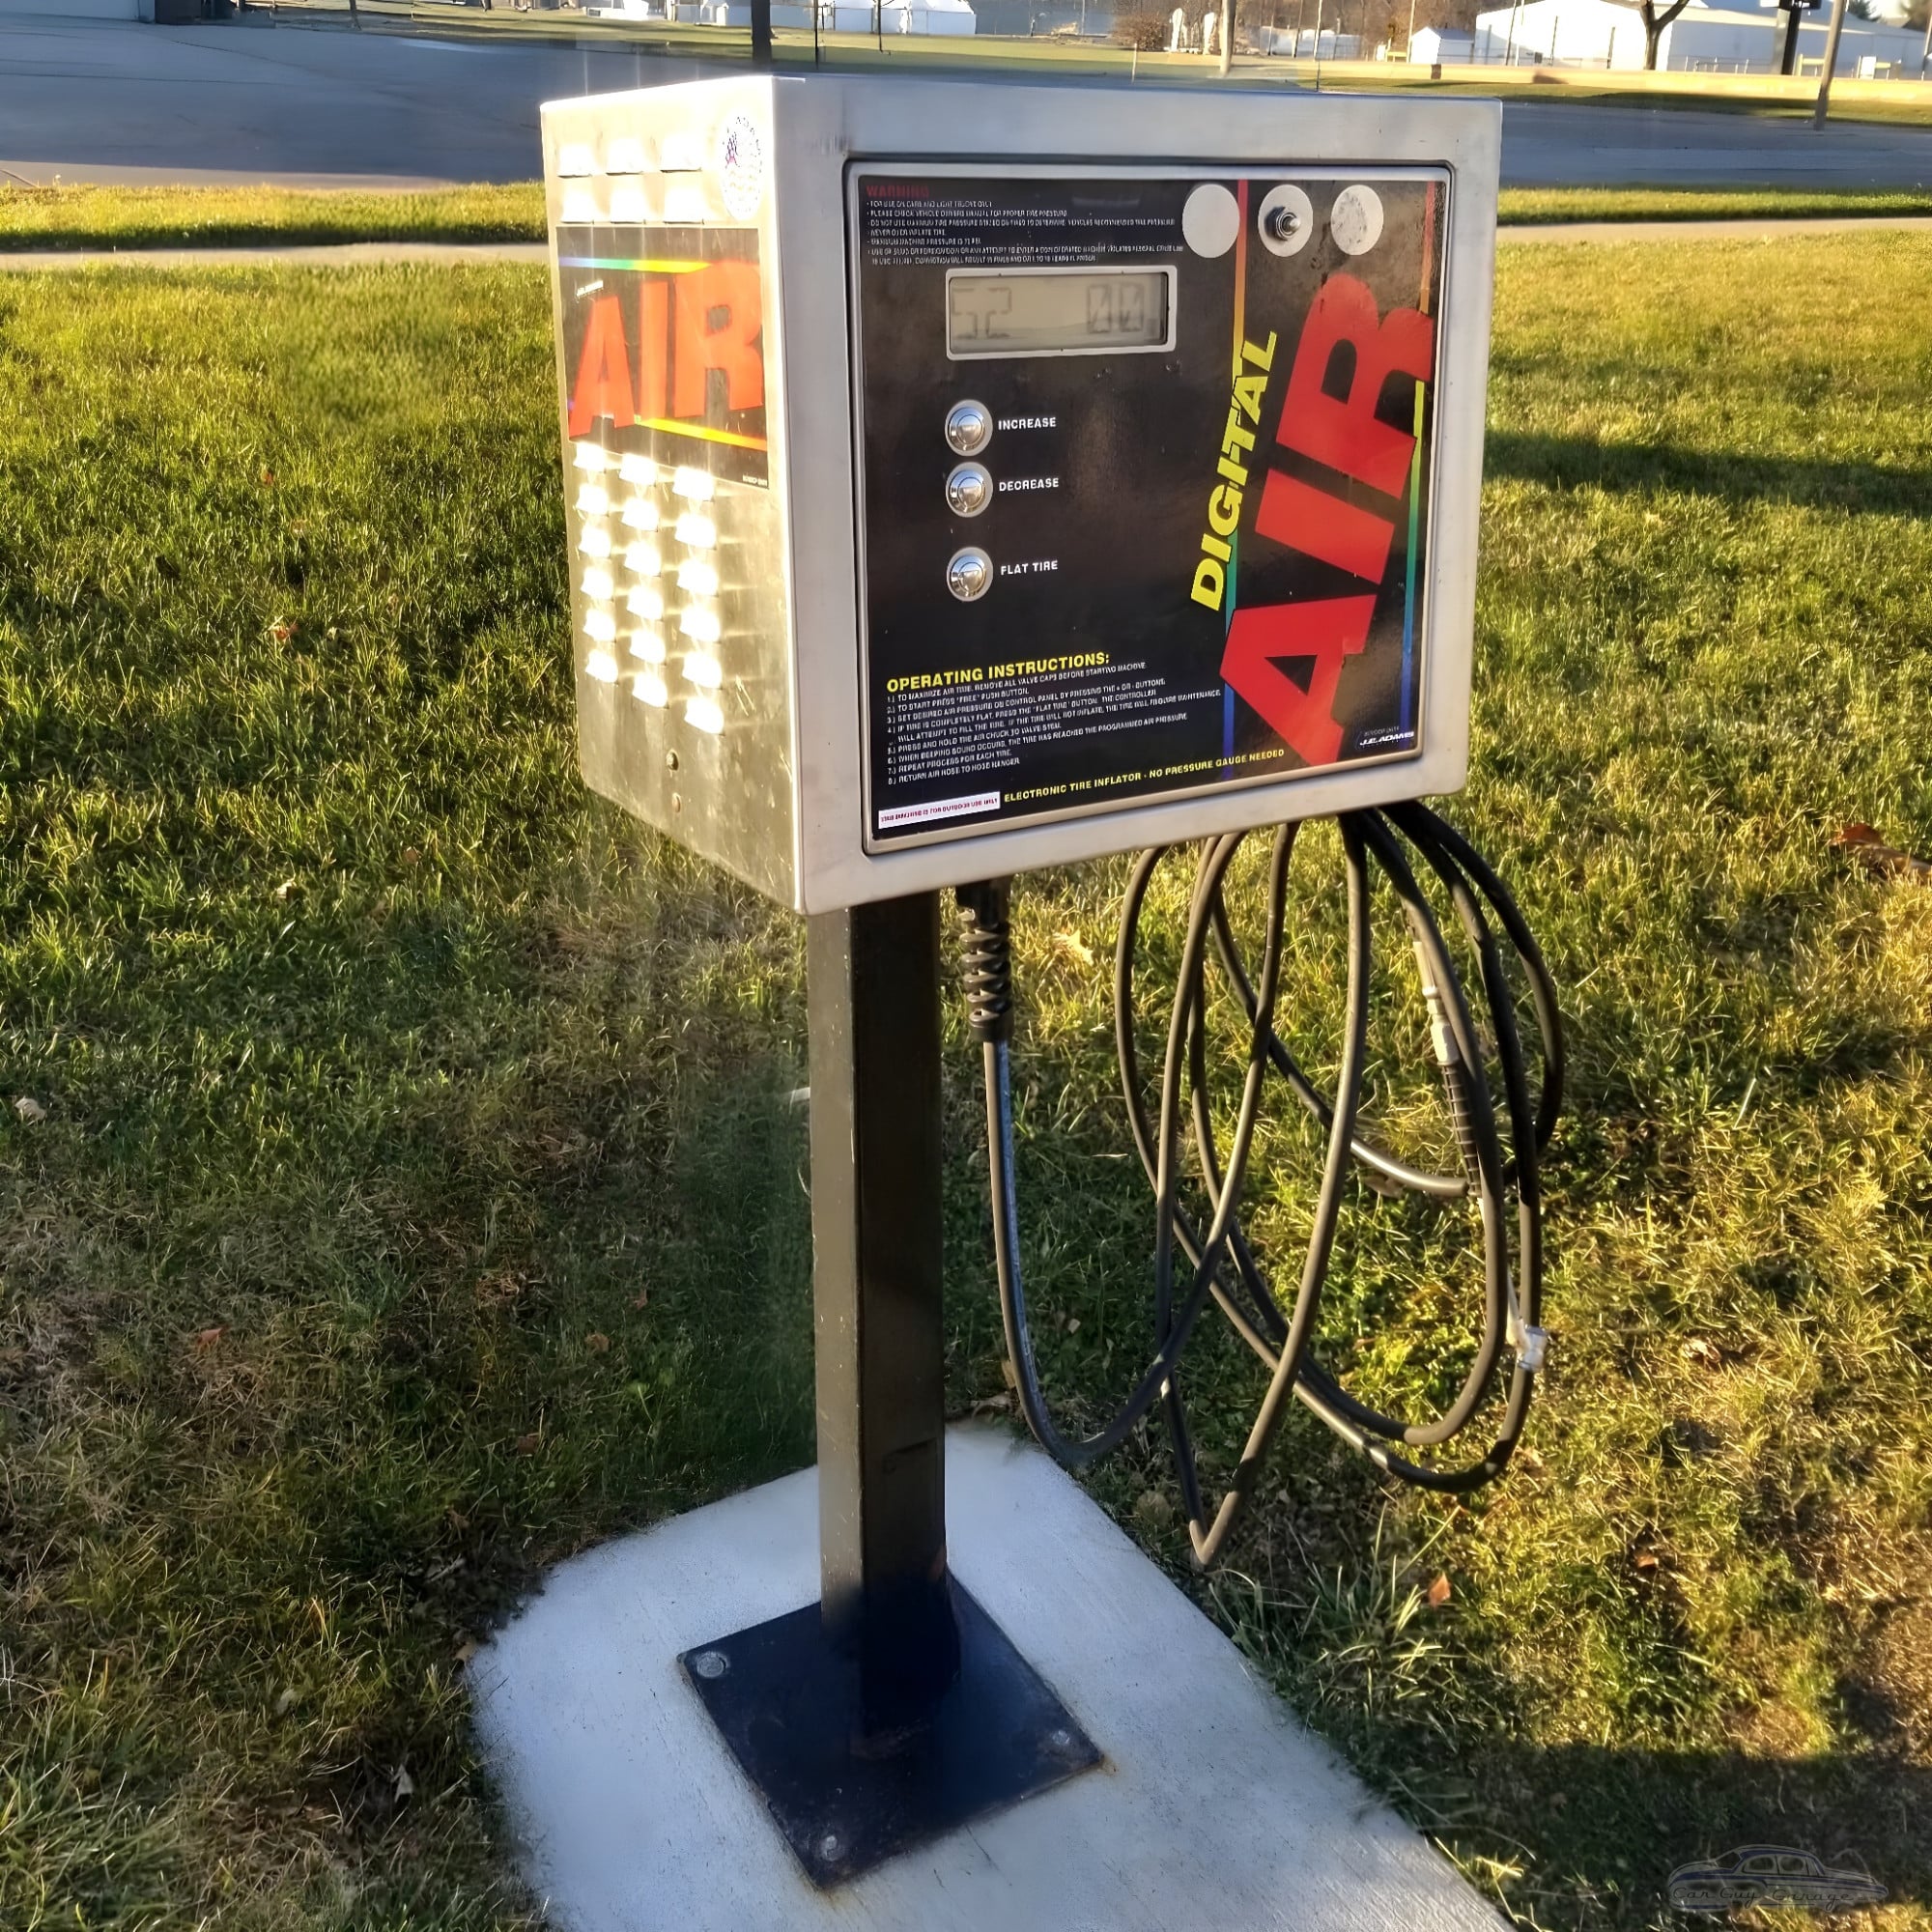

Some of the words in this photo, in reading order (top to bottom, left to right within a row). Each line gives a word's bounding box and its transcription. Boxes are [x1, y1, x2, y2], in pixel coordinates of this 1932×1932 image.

[569, 259, 764, 439] AIR
[998, 417, 1057, 431] INCREASE
[999, 477, 1060, 492] DECREASE
[1190, 331, 1277, 611] DIGITAL
[1219, 271, 1435, 766] AIR
[1001, 563, 1029, 576] FLAT
[1033, 560, 1059, 572] TIRE
[886, 668, 983, 693] OPERATING
[988, 651, 1109, 680] INSTRUCTIONS:
[1005, 784, 1066, 803] ELECTRONIC
[1069, 781, 1092, 792] TIRE
[1094, 772, 1141, 788] INFLATOR
[1150, 769, 1163, 779] NO
[1165, 760, 1213, 776] PRESSURE
[1216, 754, 1247, 768] GAUGE
[1249, 749, 1285, 762] NEEDED
